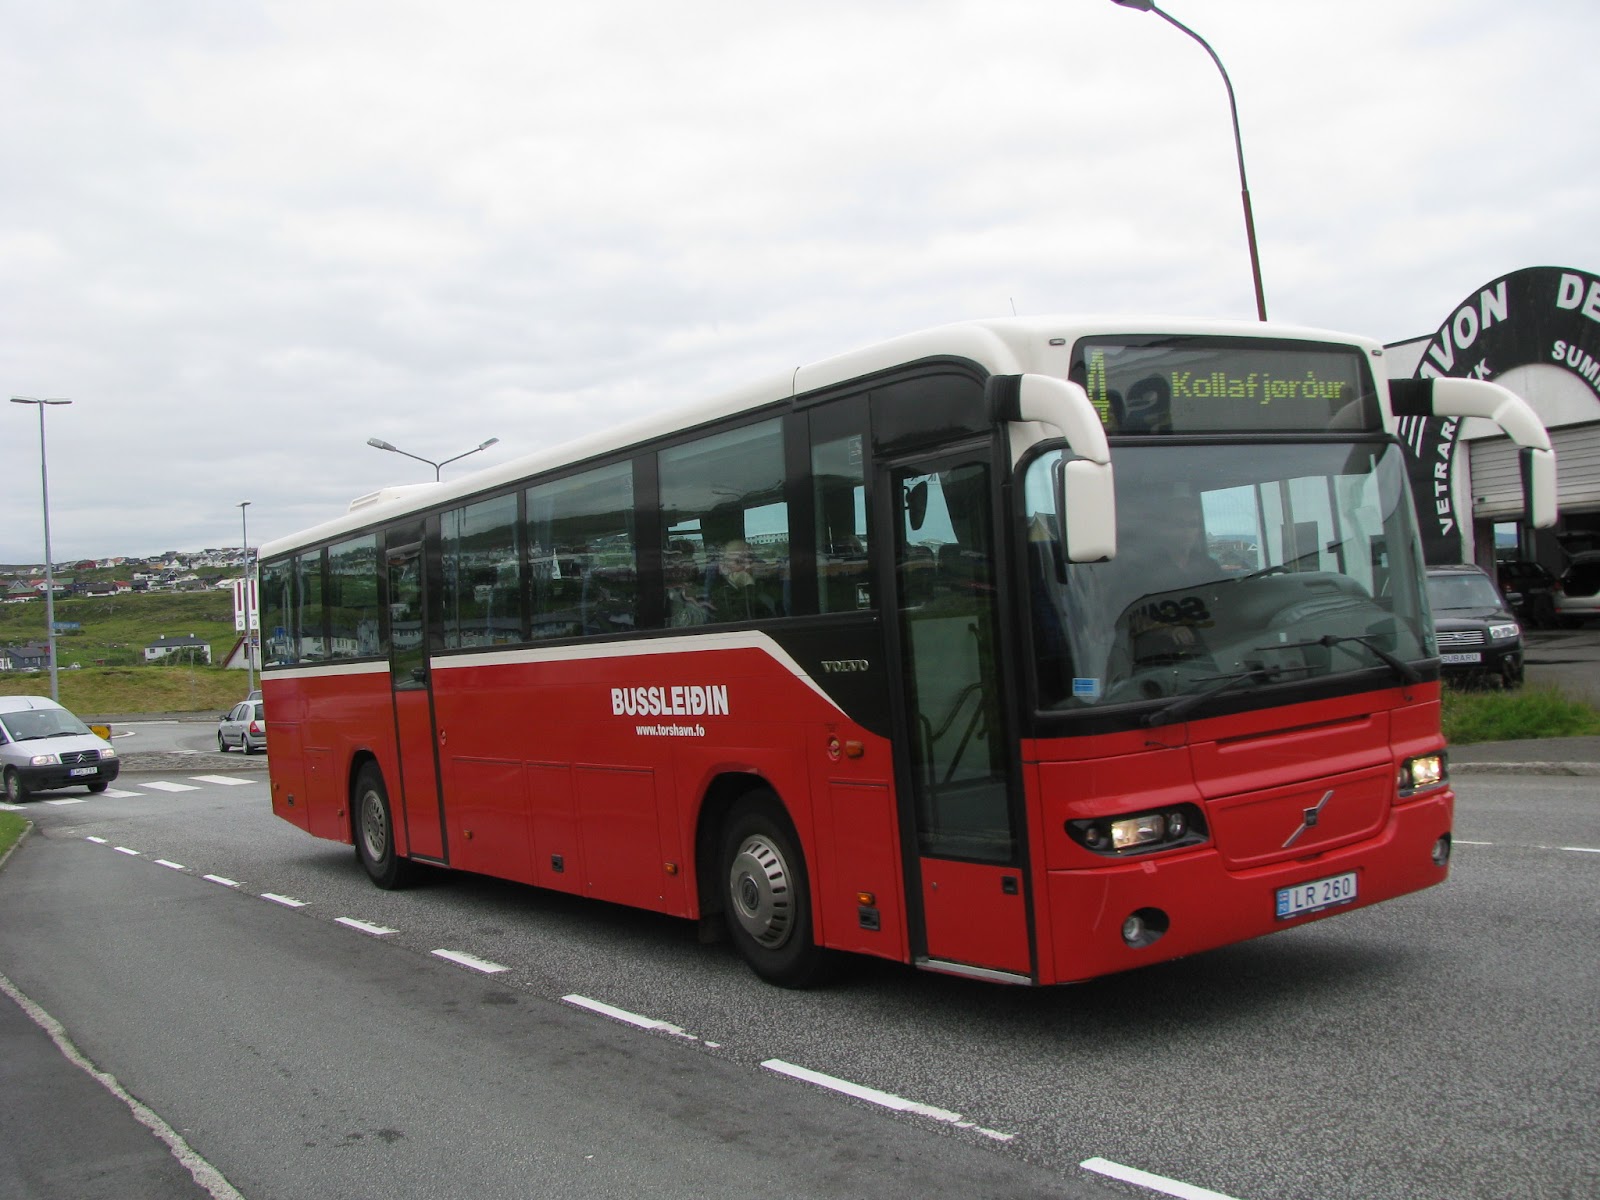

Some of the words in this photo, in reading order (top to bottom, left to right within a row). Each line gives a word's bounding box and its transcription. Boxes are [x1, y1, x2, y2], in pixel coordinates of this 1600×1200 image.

[1087, 349, 1110, 423] 4
[1172, 371, 1345, 404] Kollafjørður
[821, 659, 869, 673] VOLVO
[1442, 654, 1478, 663] SUBARU
[612, 685, 729, 715] BUSSLEIÐIN
[636, 724, 704, 736] www.torshavn.fo
[1295, 886, 1315, 908] LR
[1323, 878, 1350, 900] 260
